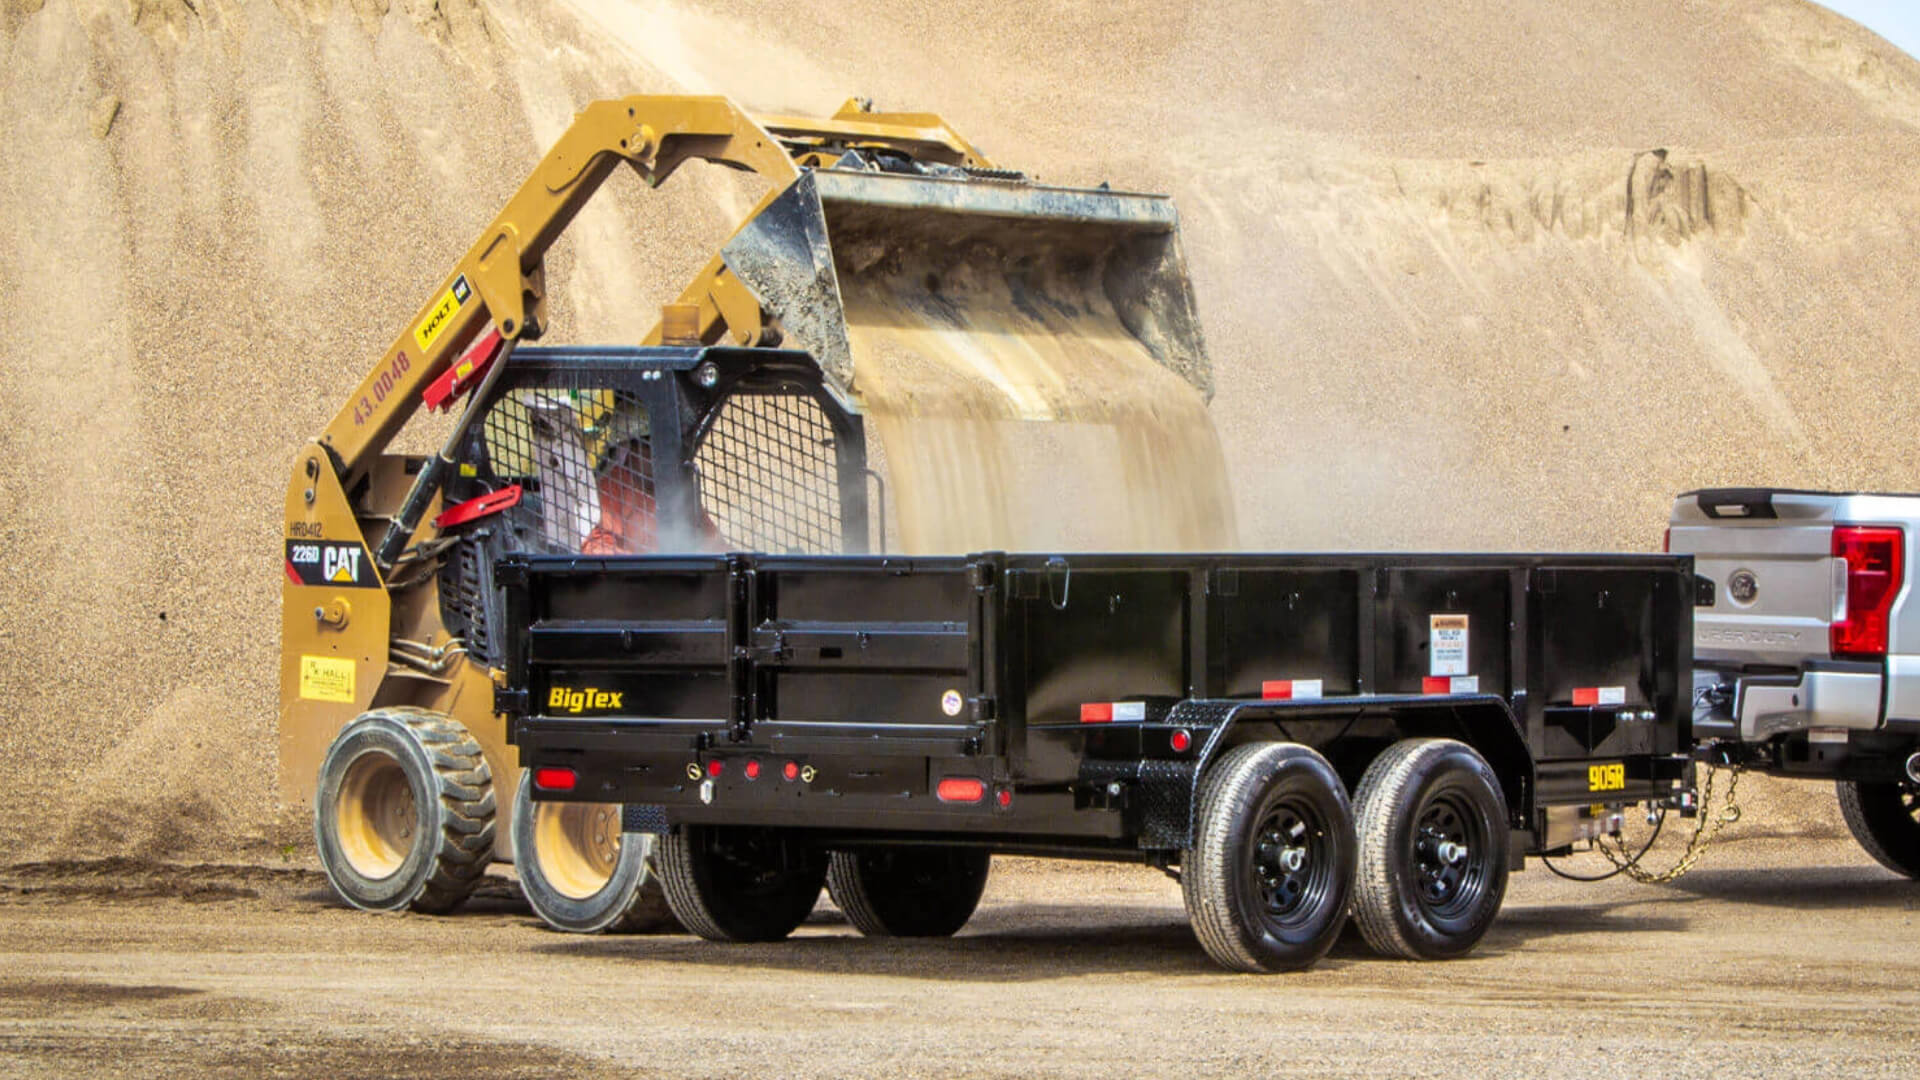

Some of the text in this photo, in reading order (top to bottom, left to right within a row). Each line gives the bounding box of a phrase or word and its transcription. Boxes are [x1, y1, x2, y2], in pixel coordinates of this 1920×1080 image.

[422, 303, 451, 339] HOLT
[354, 351, 410, 426] 43.0048
[291, 545, 362, 583] 226D CAT
[548, 686, 623, 713] BigTex
[1588, 763, 1625, 792] 90SR
